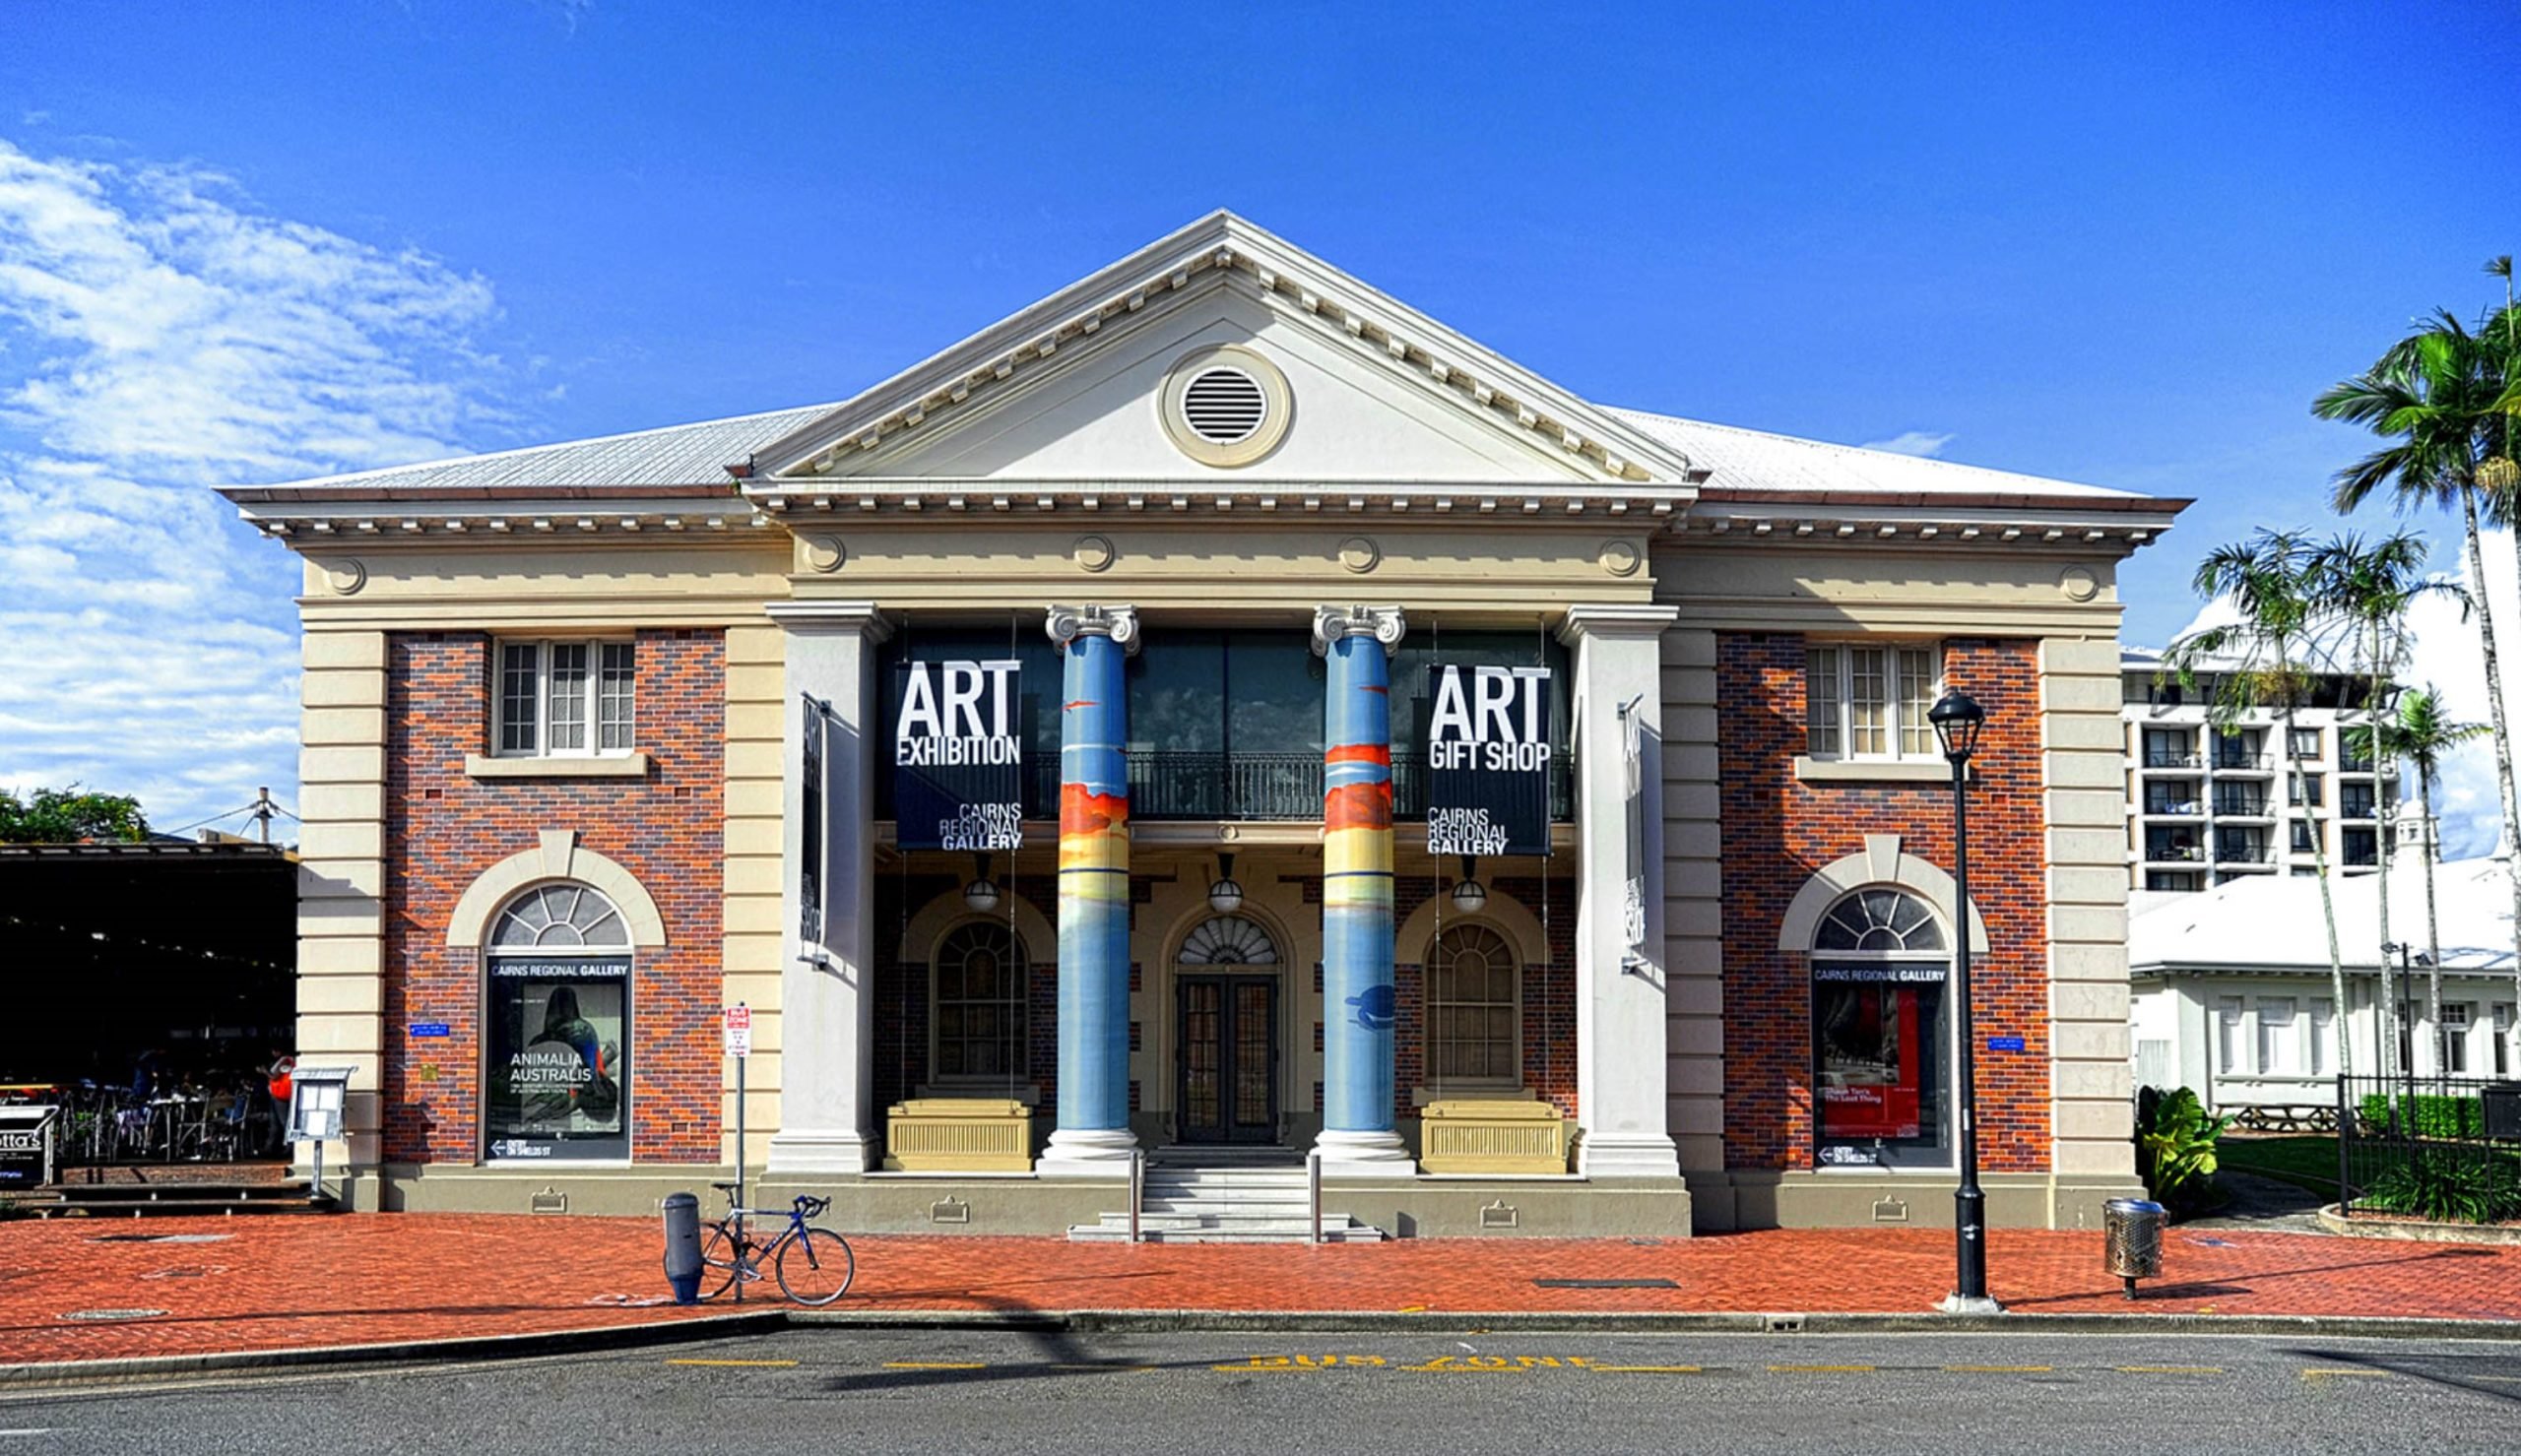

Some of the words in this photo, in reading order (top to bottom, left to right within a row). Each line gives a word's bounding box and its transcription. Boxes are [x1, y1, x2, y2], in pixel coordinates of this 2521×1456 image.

[897, 661, 1021, 737] ART
[1430, 665, 1551, 743] ART
[896, 735, 1021, 766] EXHIBITION
[1430, 740, 1481, 770] GIFT
[1485, 741, 1551, 772] SHOP
[959, 803, 1022, 820] CAIRNS
[1429, 807, 1489, 825] CAIRNS
[939, 819, 1022, 836] REGIONAL
[1429, 823, 1507, 841] REGIONAL
[942, 835, 1023, 851] GALLERY
[1428, 839, 1510, 855] GALLERY
[491, 965, 528, 977] CAIRNS
[530, 965, 578, 977] REGIONAL
[580, 965, 628, 977] GALLERY
[1815, 970, 1849, 981] CAIRNS
[1851, 970, 1898, 981] REGIONAL
[1900, 970, 1946, 981] GALLERY
[510, 1052, 583, 1066] ANIMALIA
[510, 1068, 592, 1082] AUSTRALIS
